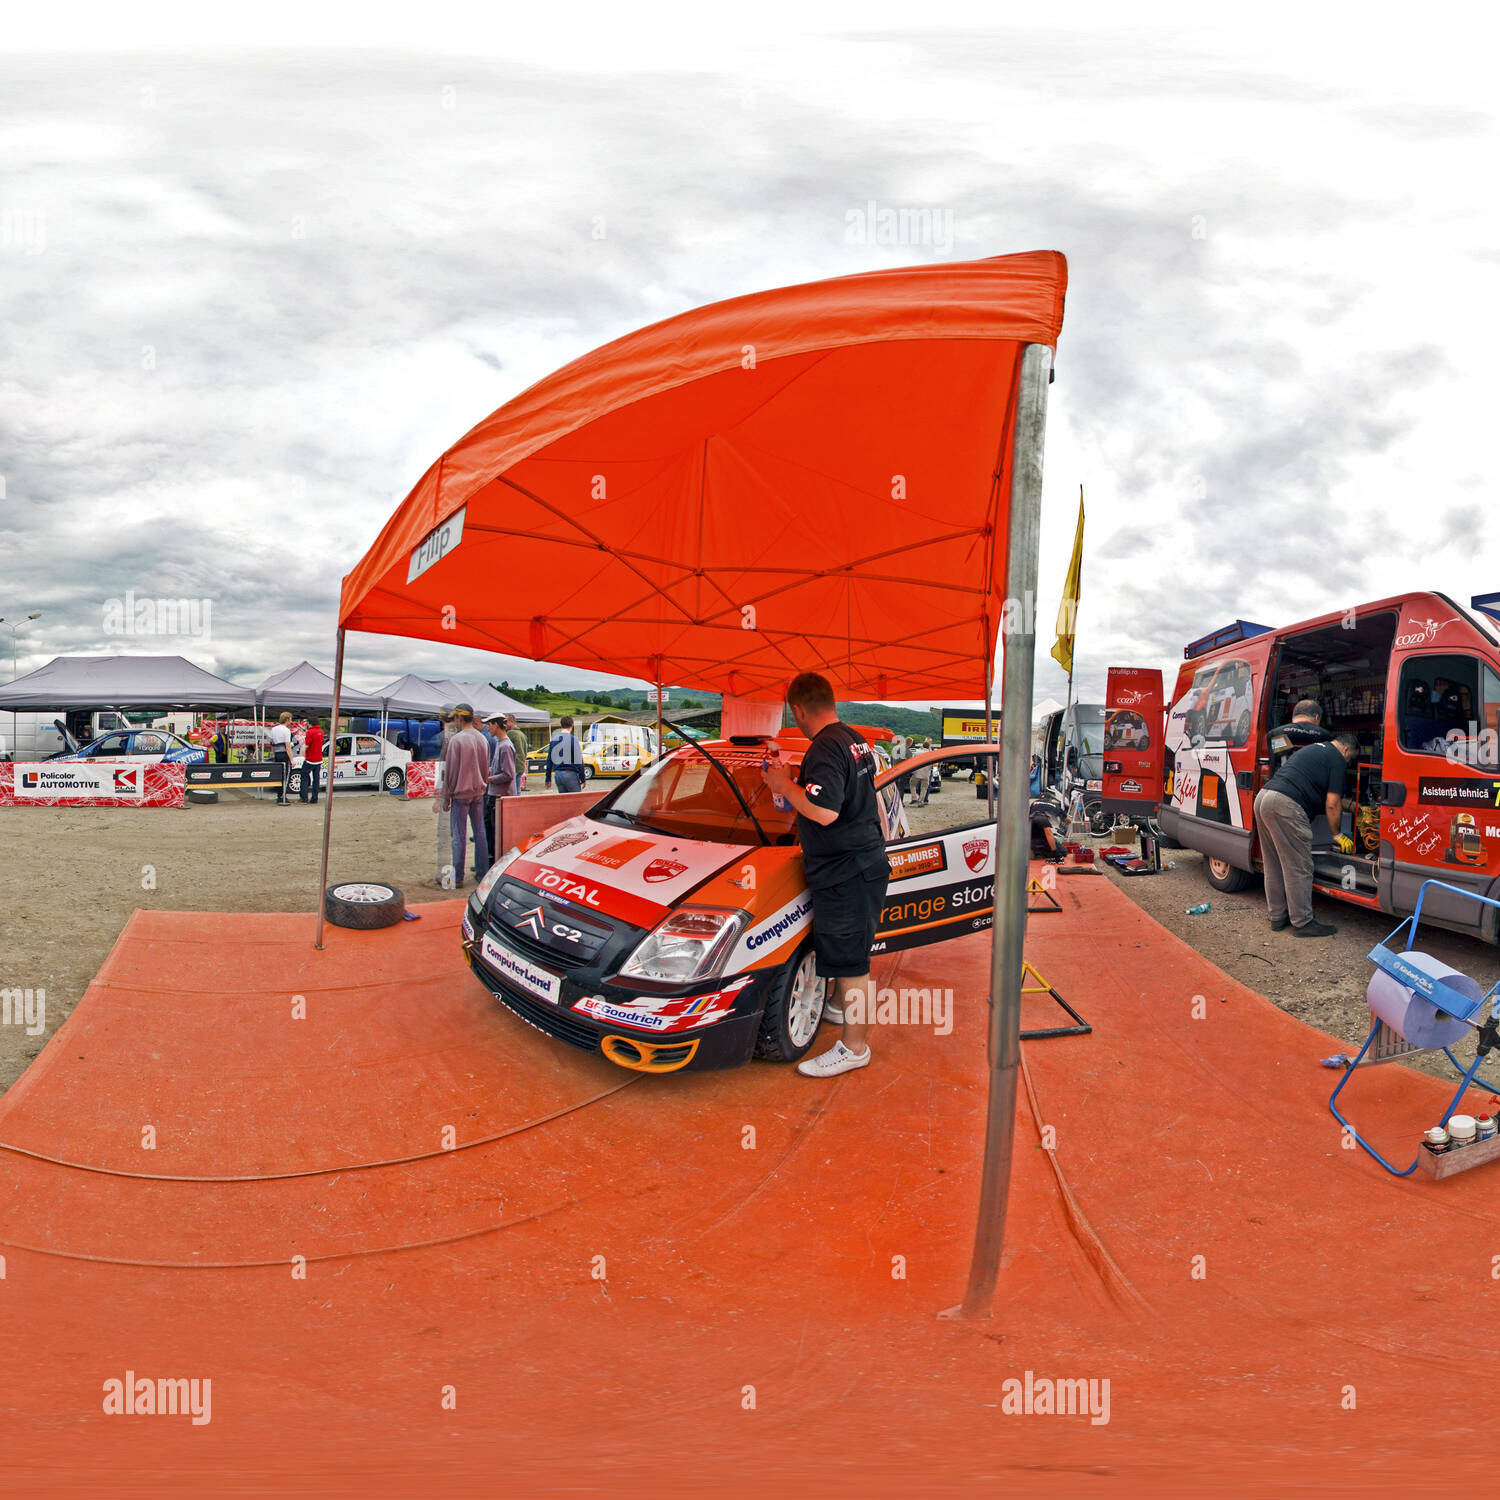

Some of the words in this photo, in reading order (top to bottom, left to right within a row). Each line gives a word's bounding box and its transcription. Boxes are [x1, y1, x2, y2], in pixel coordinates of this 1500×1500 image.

[1459, 788, 1489, 799] tehnică
[580, 850, 618, 866] orange
[533, 868, 600, 906] TOTAL
[880, 896, 946, 923] range
[552, 924, 584, 943] C2
[746, 900, 813, 950] ComputerLan
[487, 943, 552, 992] ComputerLand
[585, 999, 662, 1026] BFGoodrich
